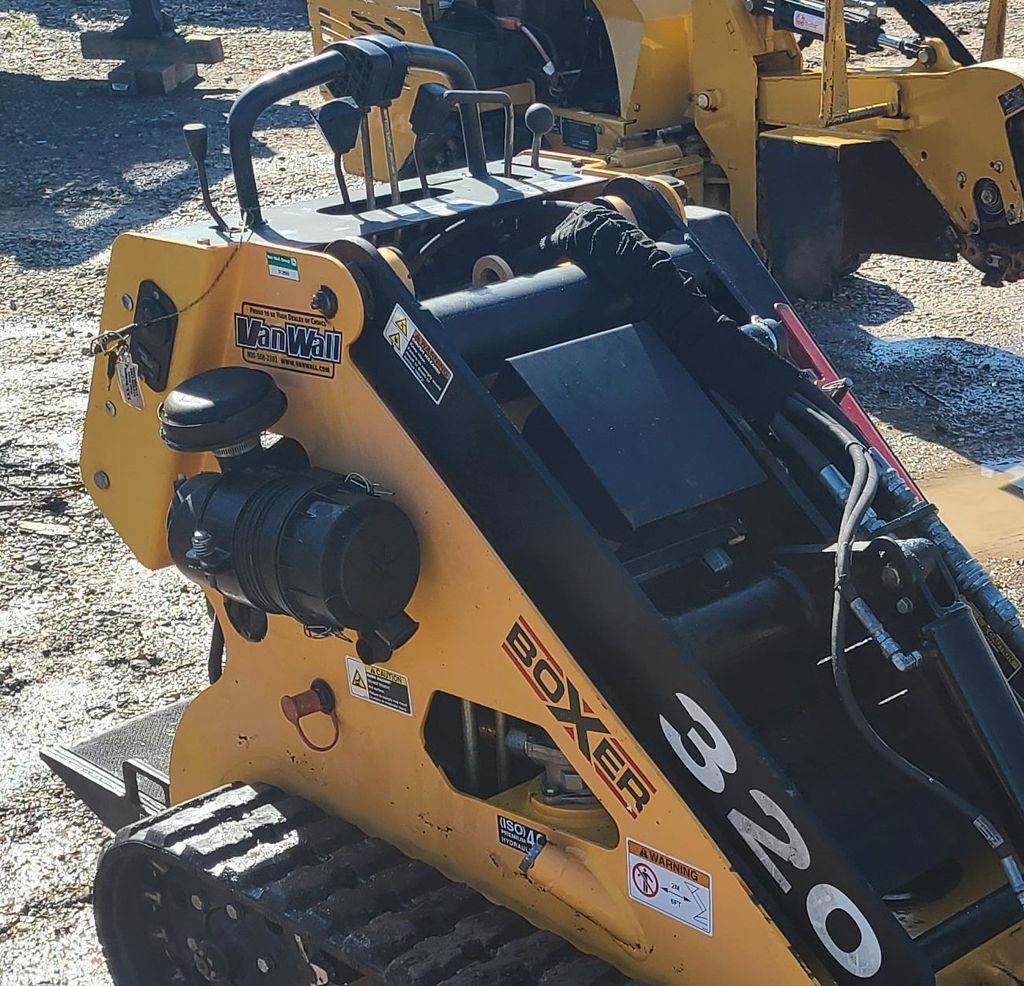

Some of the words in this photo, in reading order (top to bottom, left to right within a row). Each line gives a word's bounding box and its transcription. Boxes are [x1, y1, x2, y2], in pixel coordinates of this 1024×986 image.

[506, 621, 651, 814] BOXER
[500, 816, 526, 838] (ISO)
[659, 692, 882, 978] 320
[501, 836, 529, 853] HYDRAUL
[648, 850, 699, 882] WARNING
[671, 882, 680, 891] 2M
